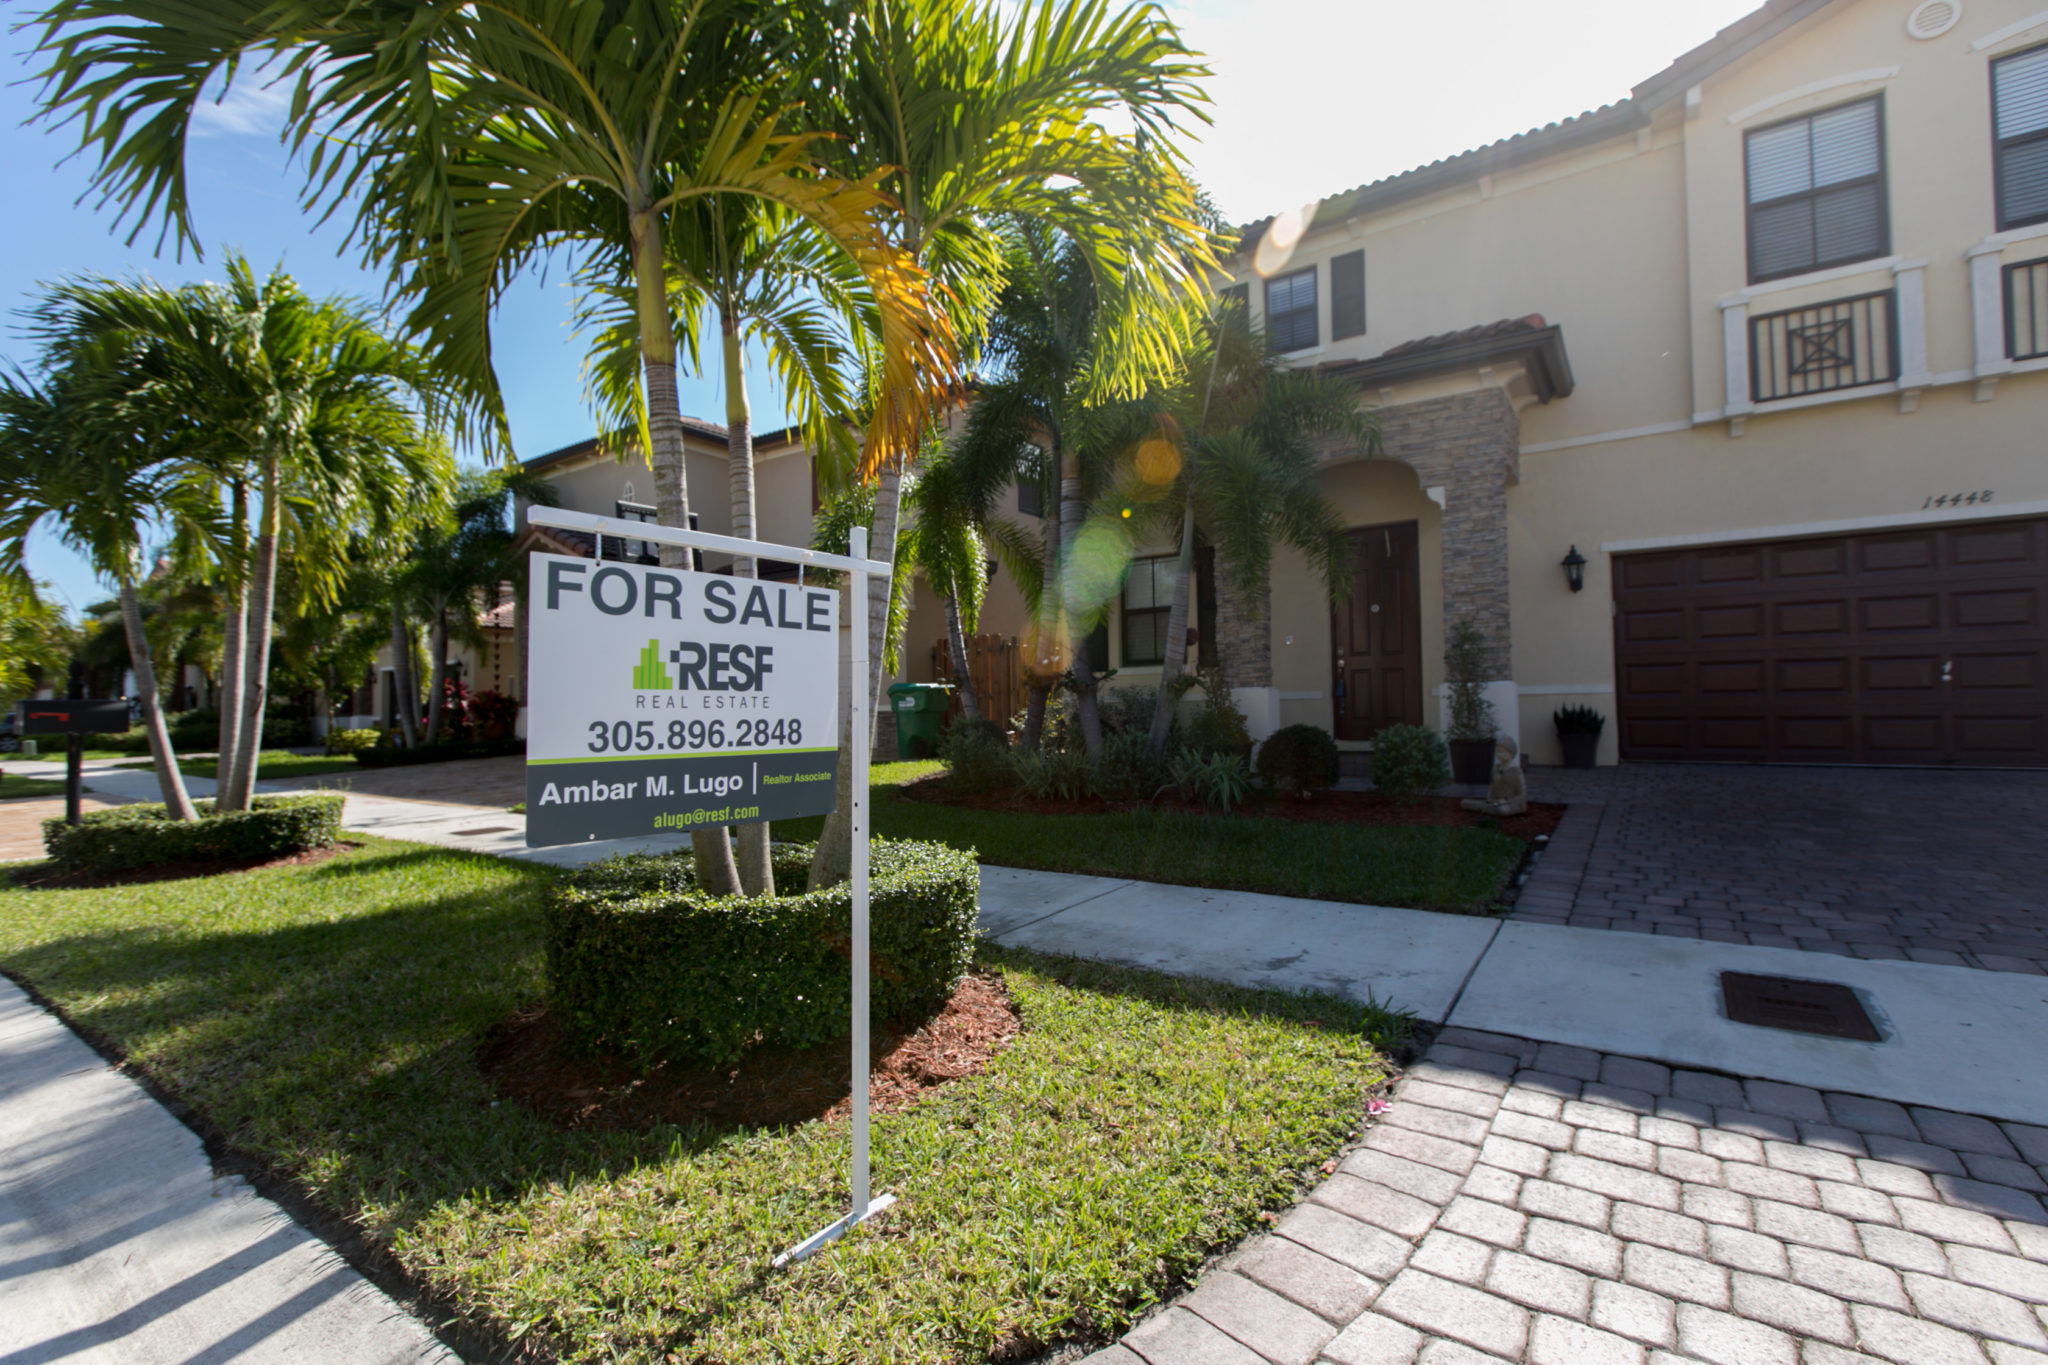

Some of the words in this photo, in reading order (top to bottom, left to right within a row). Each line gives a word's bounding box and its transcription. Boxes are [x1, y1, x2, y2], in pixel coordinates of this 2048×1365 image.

[1921, 490, 1995, 510] 14448
[546, 560, 683, 620] FOR
[703, 579, 832, 633] SALE
[670, 641, 773, 691] RESF
[636, 695, 688, 709] REAL
[703, 695, 770, 709] ESTATE
[587, 718, 803, 753] 305.896.2848
[538, 779, 637, 806] Ambar
[645, 776, 675, 797] M.
[683, 773, 744, 799] Lugo
[763, 773, 792, 785] Realtor
[794, 770, 832, 784] Associate
[653, 805, 760, 829] alugo@resf.com
